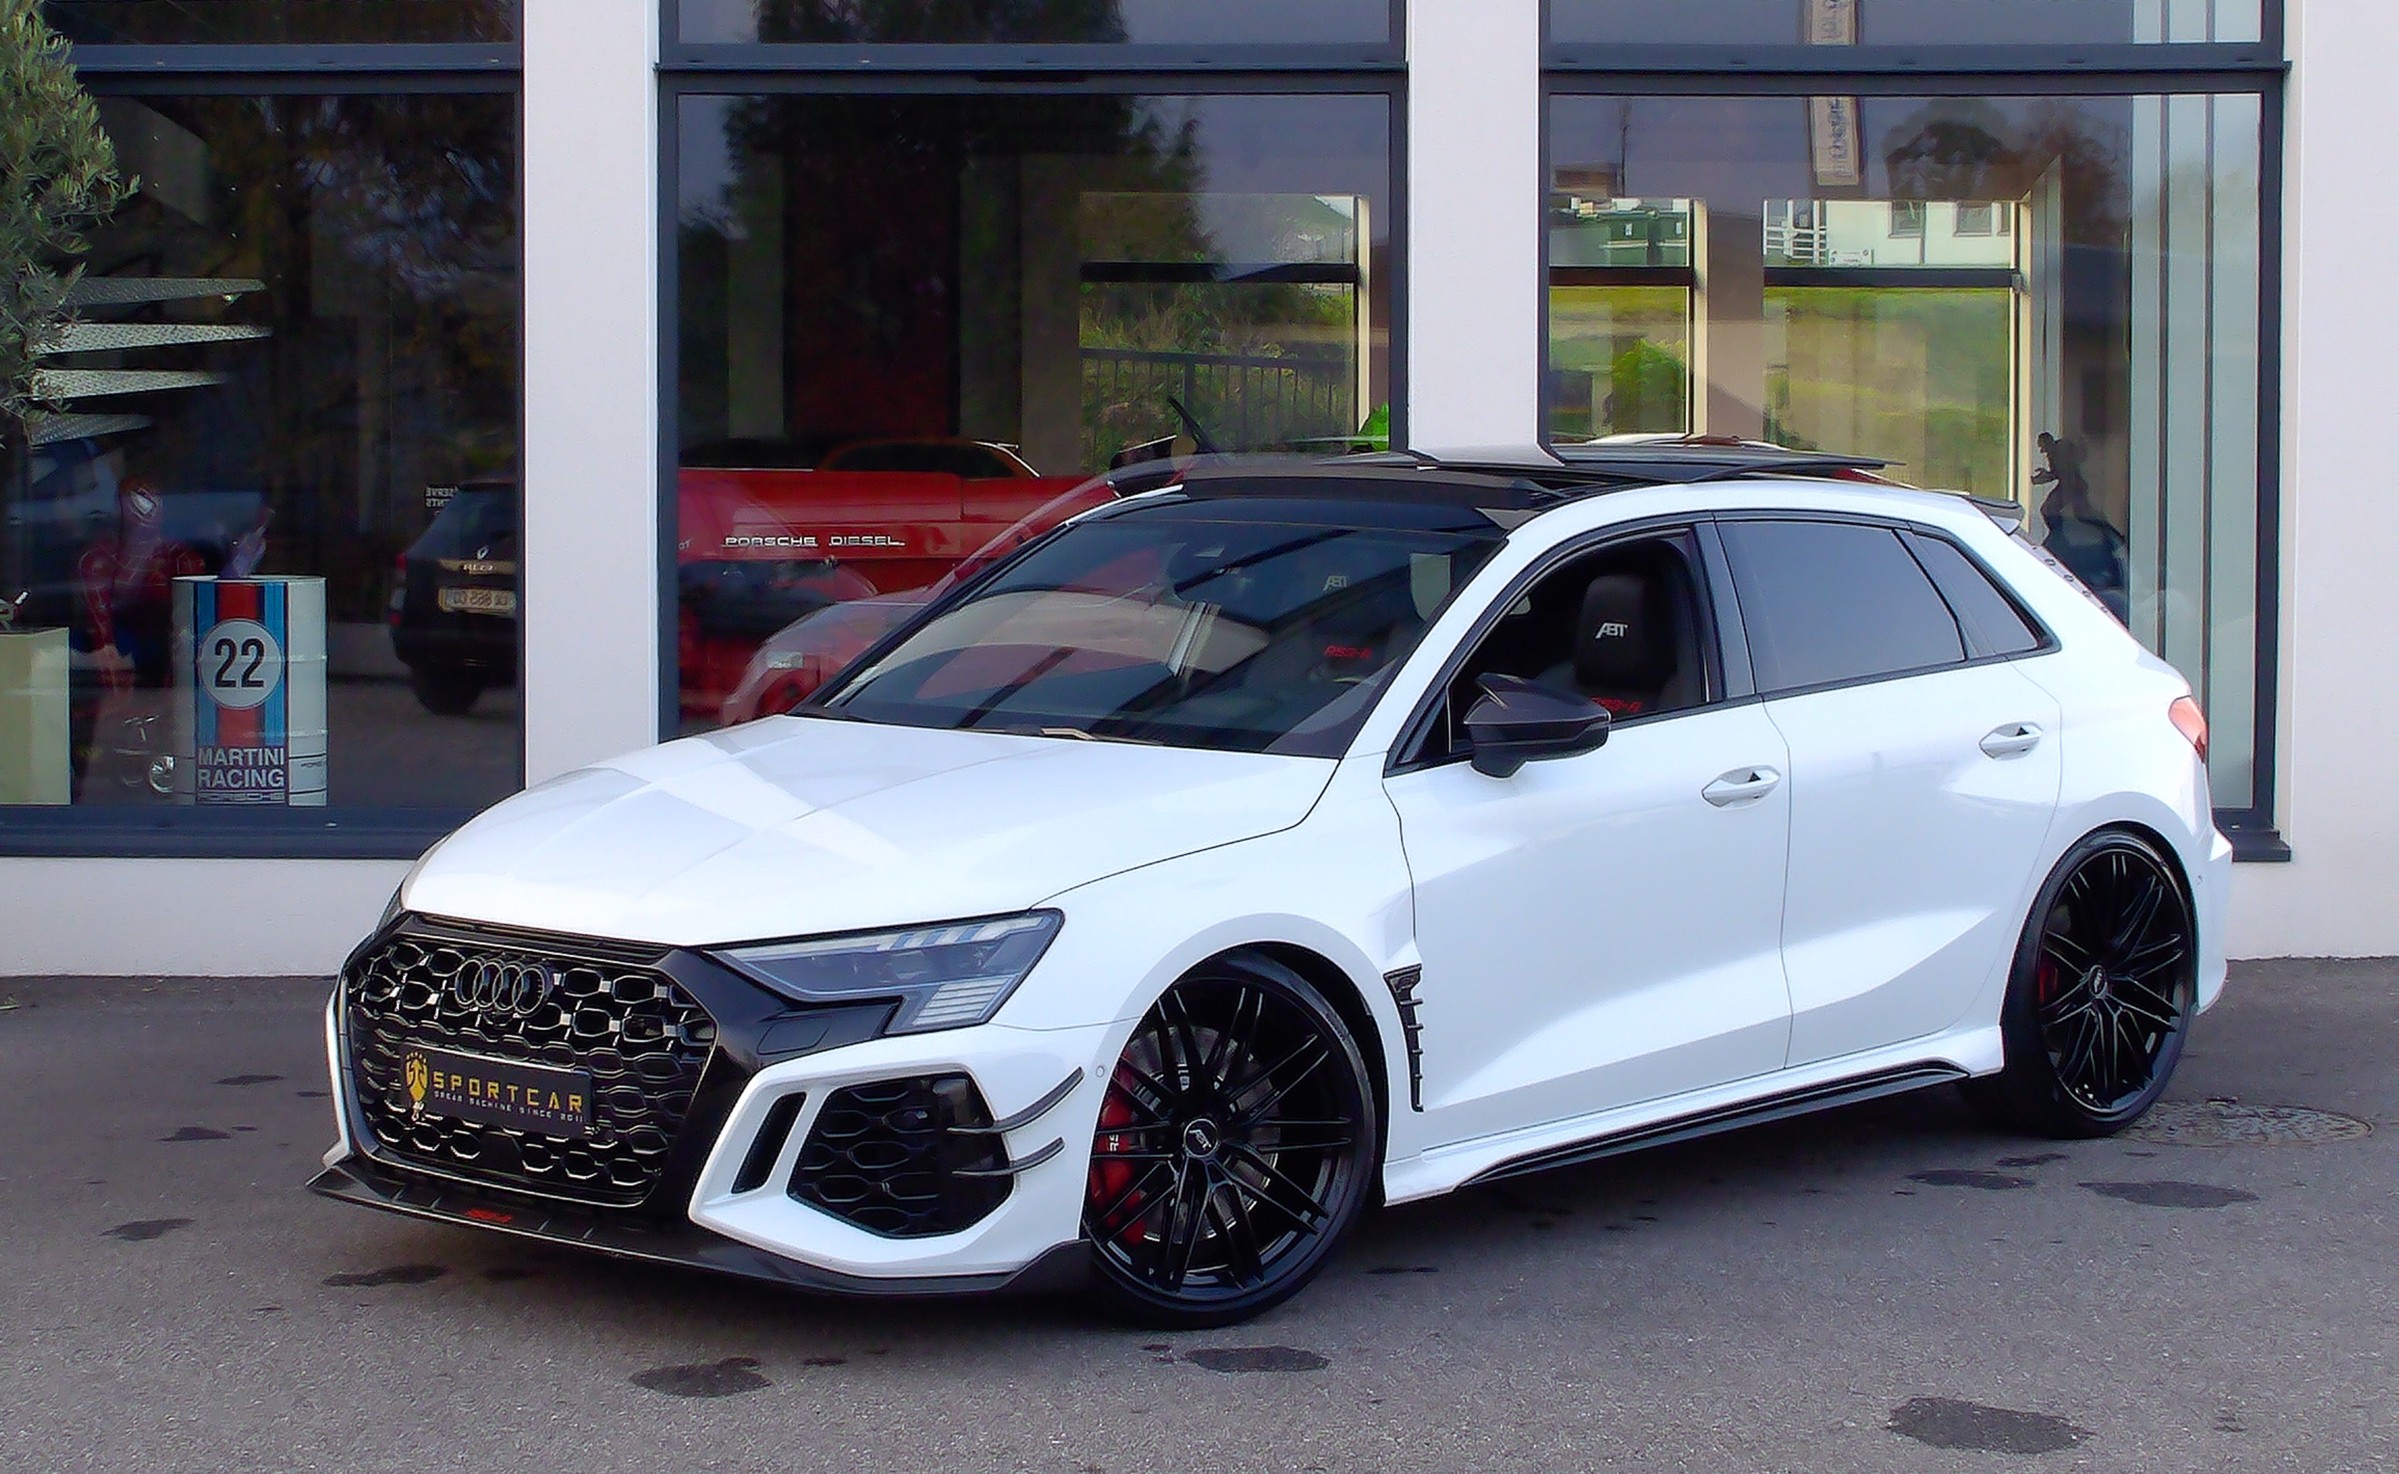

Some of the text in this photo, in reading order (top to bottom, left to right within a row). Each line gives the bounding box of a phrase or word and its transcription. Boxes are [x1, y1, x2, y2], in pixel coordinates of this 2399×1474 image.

[724, 535, 905, 547] PORSCHE DIESEL
[1595, 622, 1628, 639] ABT
[214, 637, 265, 688] 22
[198, 747, 285, 766] MARTINI
[198, 768, 285, 788] RACING
[432, 1070, 583, 1112] SPORTCAR
